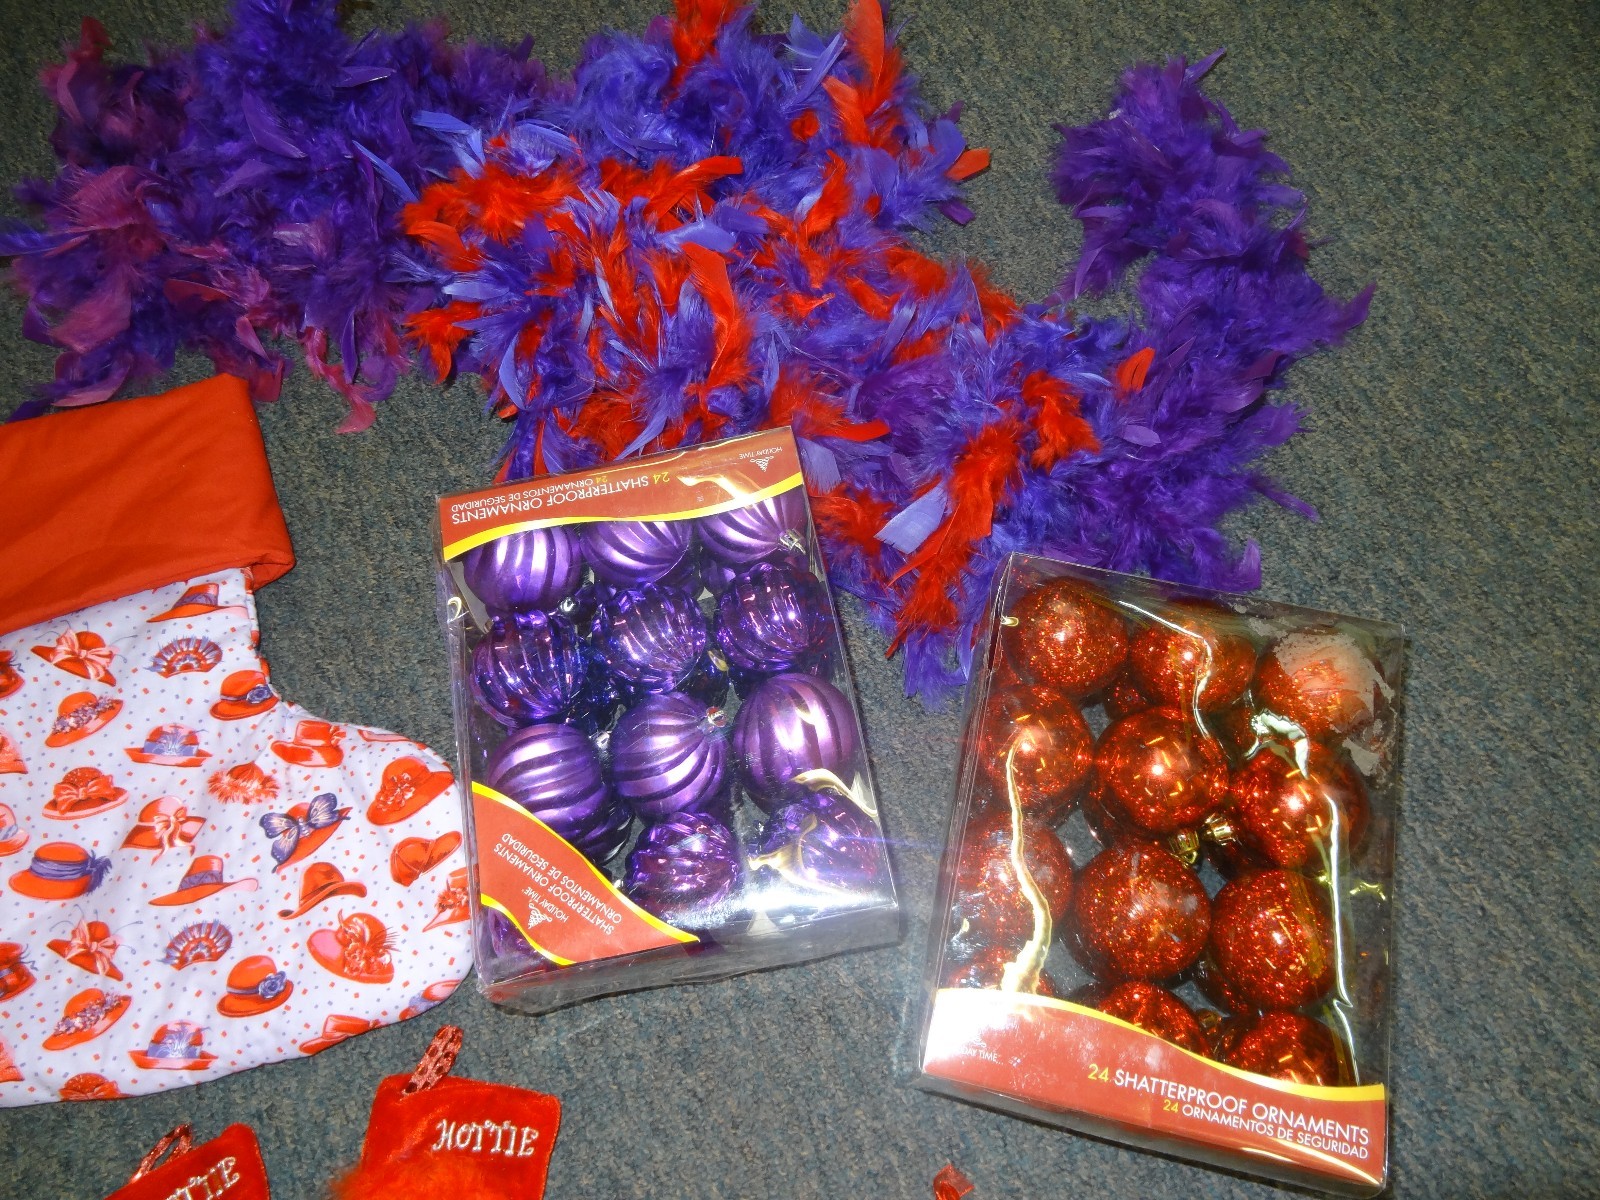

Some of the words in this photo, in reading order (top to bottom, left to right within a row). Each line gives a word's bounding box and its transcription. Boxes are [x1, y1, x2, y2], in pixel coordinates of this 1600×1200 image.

[738, 451, 755, 460] TIME
[523, 478, 594, 499] ORNAMENTOS
[546, 475, 649, 507] SHATTERPROOF
[596, 475, 608, 485] 24
[652, 471, 670, 485] 24
[451, 495, 506, 513] SEGURIDAD
[451, 496, 543, 525] ORNAMENTS
[508, 493, 521, 502] DE
[501, 833, 549, 870] SEGURIDAD
[493, 843, 549, 887] ORNAMENTS
[547, 866, 561, 878] DE
[523, 886, 542, 902] TIME
[560, 875, 623, 924] ORNAMENTOS
[539, 899, 570, 923] HOLIDAY
[547, 884, 615, 936] SHATTERPROOF
[1087, 1063, 1110, 1083] 24
[1114, 1068, 1248, 1115] SHATTERPROOF
[1252, 1102, 1370, 1145] ORNAMENTS
[432, 1118, 540, 1157] HOTTIE
[1163, 1099, 1180, 1114] 24
[1181, 1104, 1275, 1137] ORNAMENTOS
[1277, 1127, 1294, 1142] DE
[1296, 1131, 1369, 1160] SEGURIDAD
